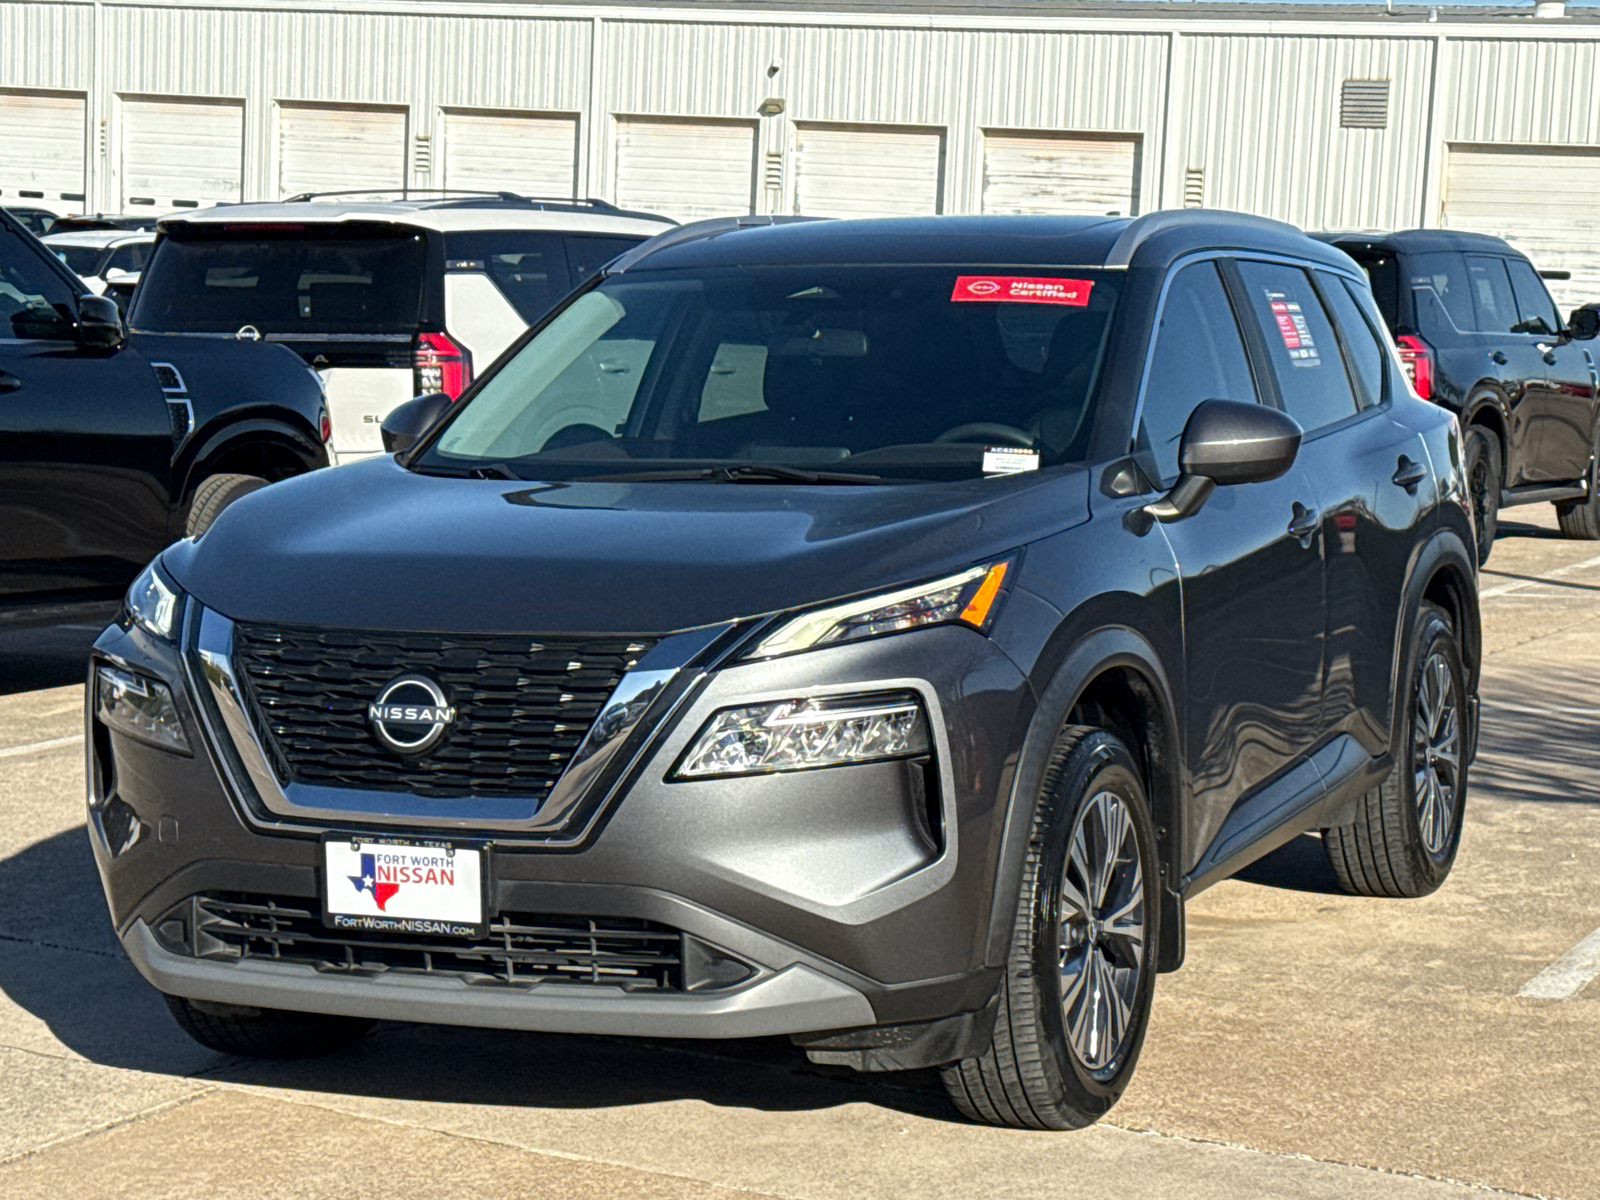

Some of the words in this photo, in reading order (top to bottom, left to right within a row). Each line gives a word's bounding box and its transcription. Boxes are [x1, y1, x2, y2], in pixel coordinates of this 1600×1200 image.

[1011, 282, 1064, 291] Nissan
[1009, 289, 1077, 299] Certified
[370, 706, 450, 721] NISSAN
[378, 838, 410, 846] WORTH
[424, 840, 453, 849] TEXAS
[377, 854, 407, 865] FORT
[410, 856, 454, 868] WORTH
[377, 866, 454, 886] NISSAN
